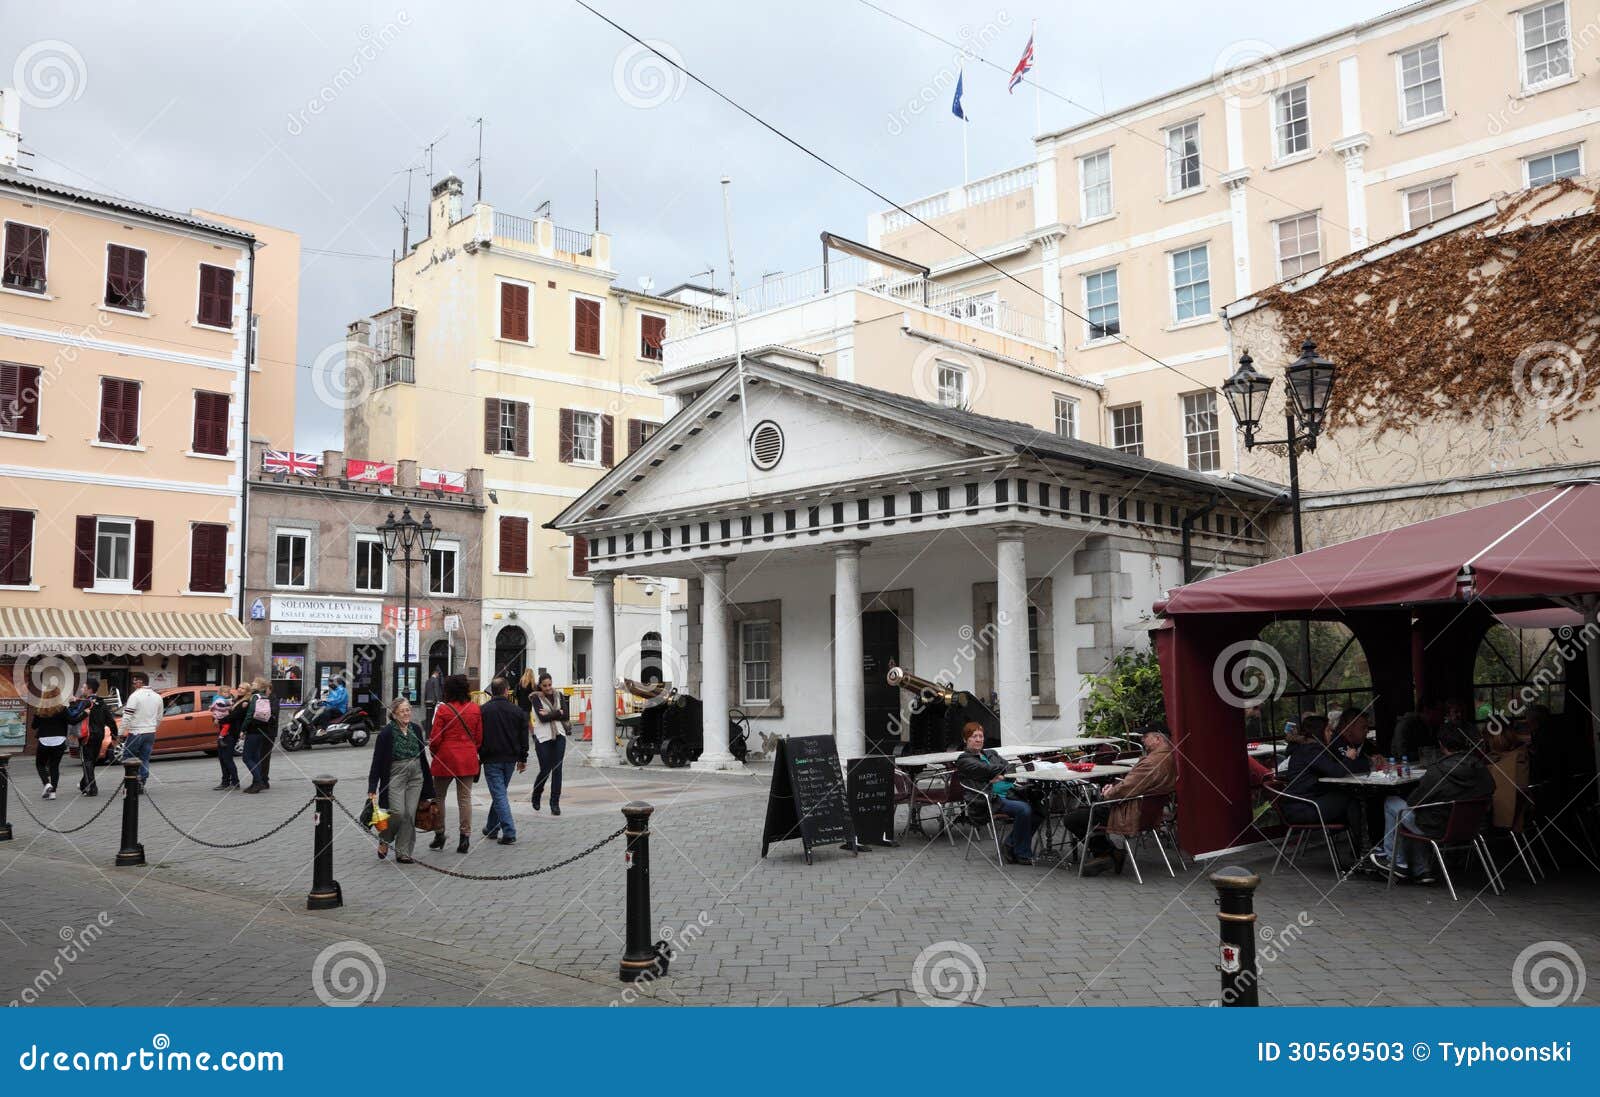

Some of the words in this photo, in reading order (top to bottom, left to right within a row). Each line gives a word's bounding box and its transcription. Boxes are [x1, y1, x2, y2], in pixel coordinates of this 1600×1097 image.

[281, 600, 326, 610] SOLOMON
[328, 602, 353, 611] LEVY
[34, 643, 71, 652] AMAR
[75, 643, 124, 652] BAKERY
[127, 643, 137, 652] &
[140, 643, 235, 652] CONFECTIONERY
